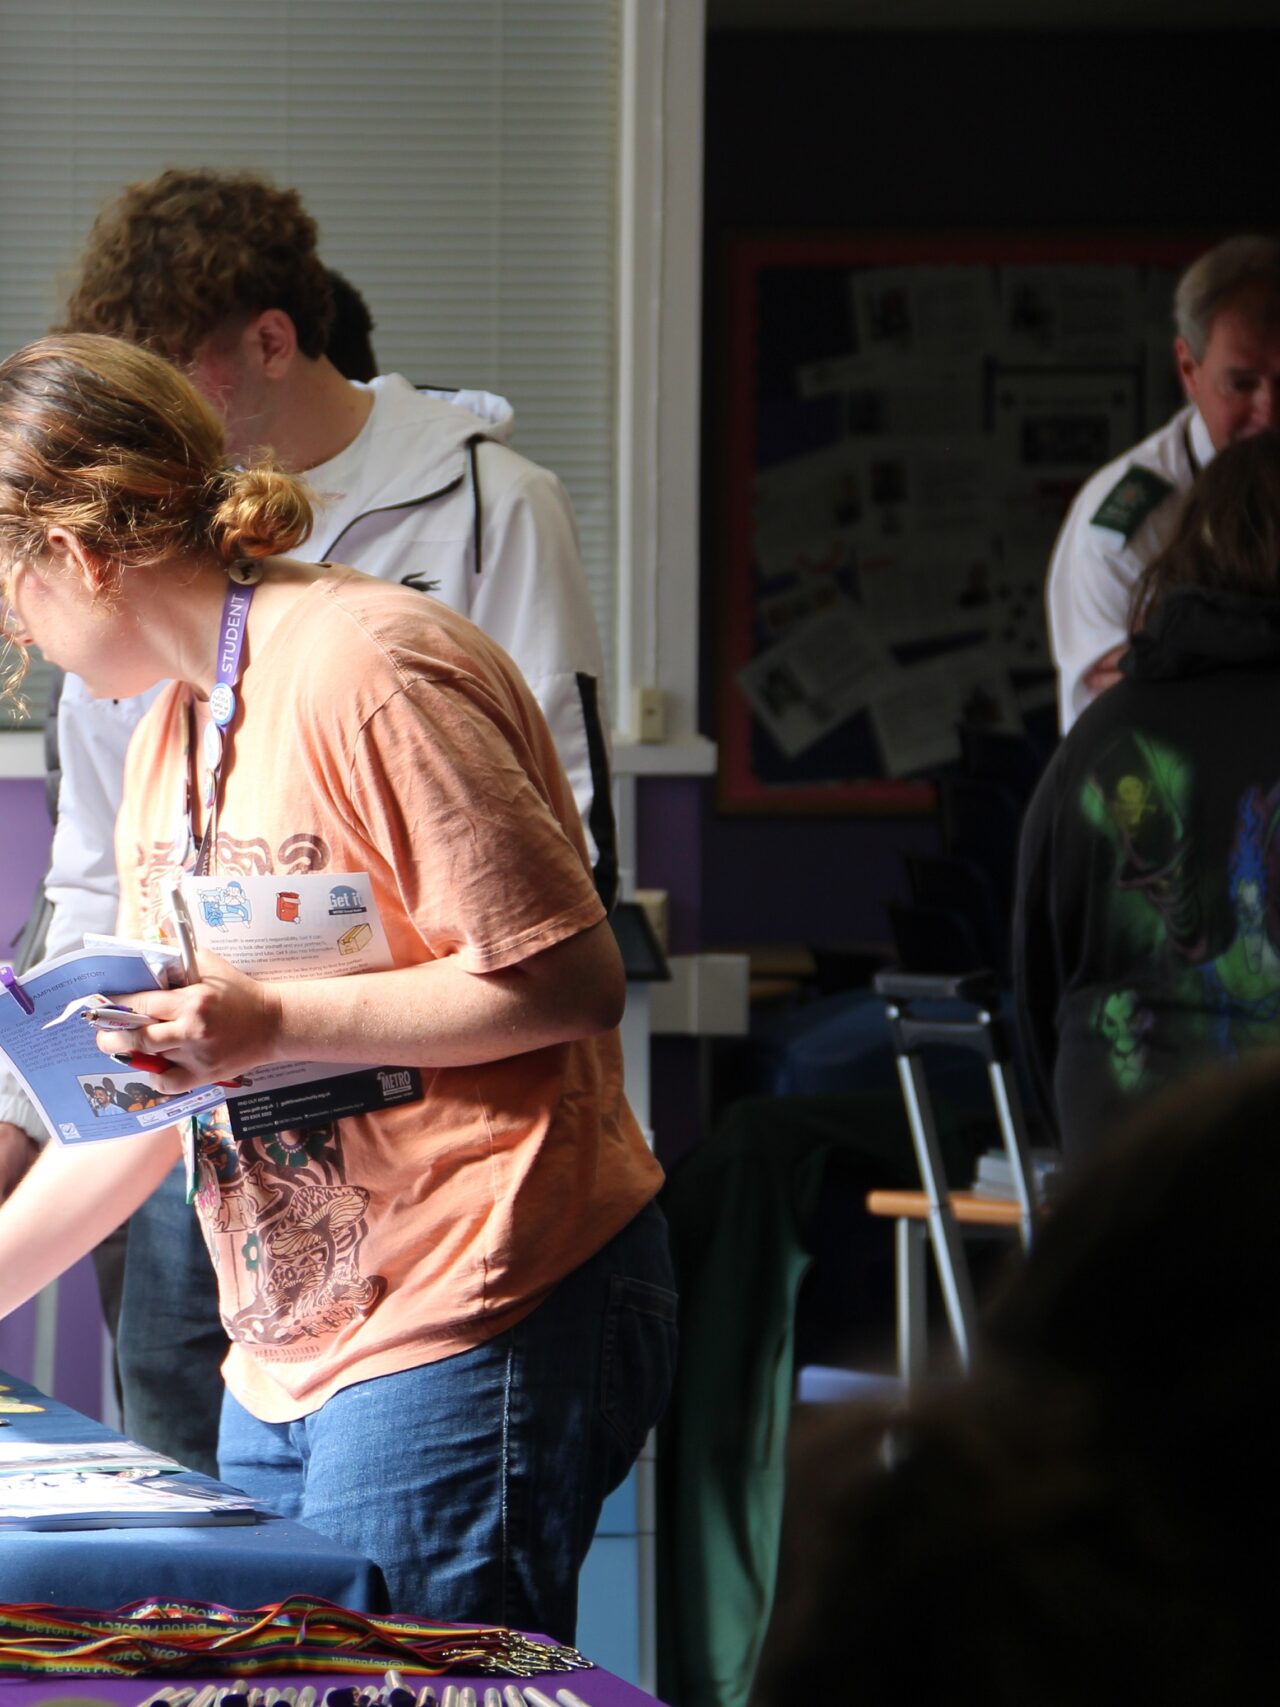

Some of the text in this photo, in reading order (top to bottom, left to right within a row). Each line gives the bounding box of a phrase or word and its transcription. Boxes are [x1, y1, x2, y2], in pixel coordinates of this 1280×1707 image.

[222, 594, 245, 673] STUDENT
[328, 892, 351, 908] Get
[382, 1070, 411, 1092] METRO
